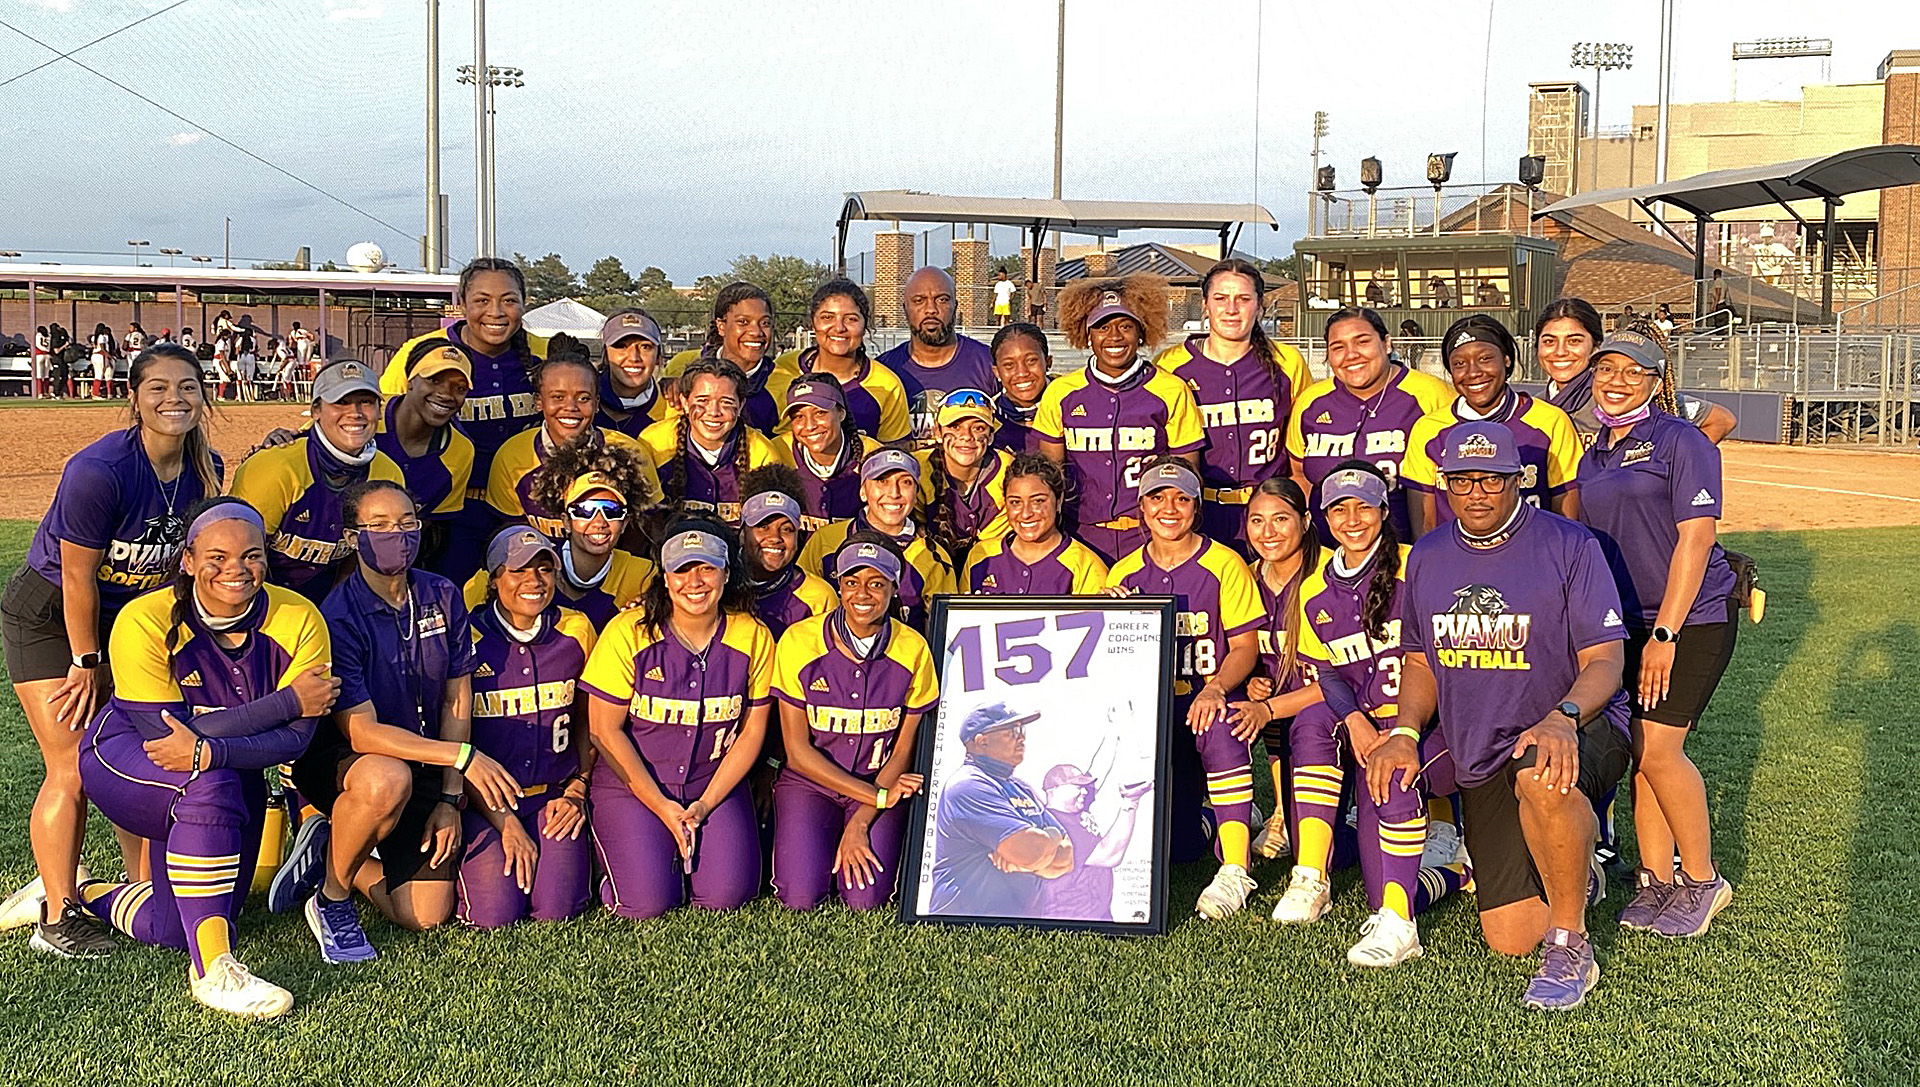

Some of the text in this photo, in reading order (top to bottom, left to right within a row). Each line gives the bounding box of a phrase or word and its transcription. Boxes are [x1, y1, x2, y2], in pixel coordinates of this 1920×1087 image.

[133, 337, 140, 346] 2
[1248, 427, 1280, 465] 28
[1124, 455, 1158, 489] 2
[1108, 622, 1150, 631] CAREER
[1108, 634, 1162, 643] COACHING
[1431, 613, 1531, 650] PVAMU
[947, 610, 1106, 692] 157
[1107, 646, 1135, 654] WINS
[1181, 638, 1217, 676] 18
[1438, 648, 1531, 670] SOFTBALL
[629, 690, 743, 727] PANTHERS
[553, 713, 570, 753] 6
[867, 738, 893, 769] 1
[921, 700, 948, 883] COACH VERNON BLAND
